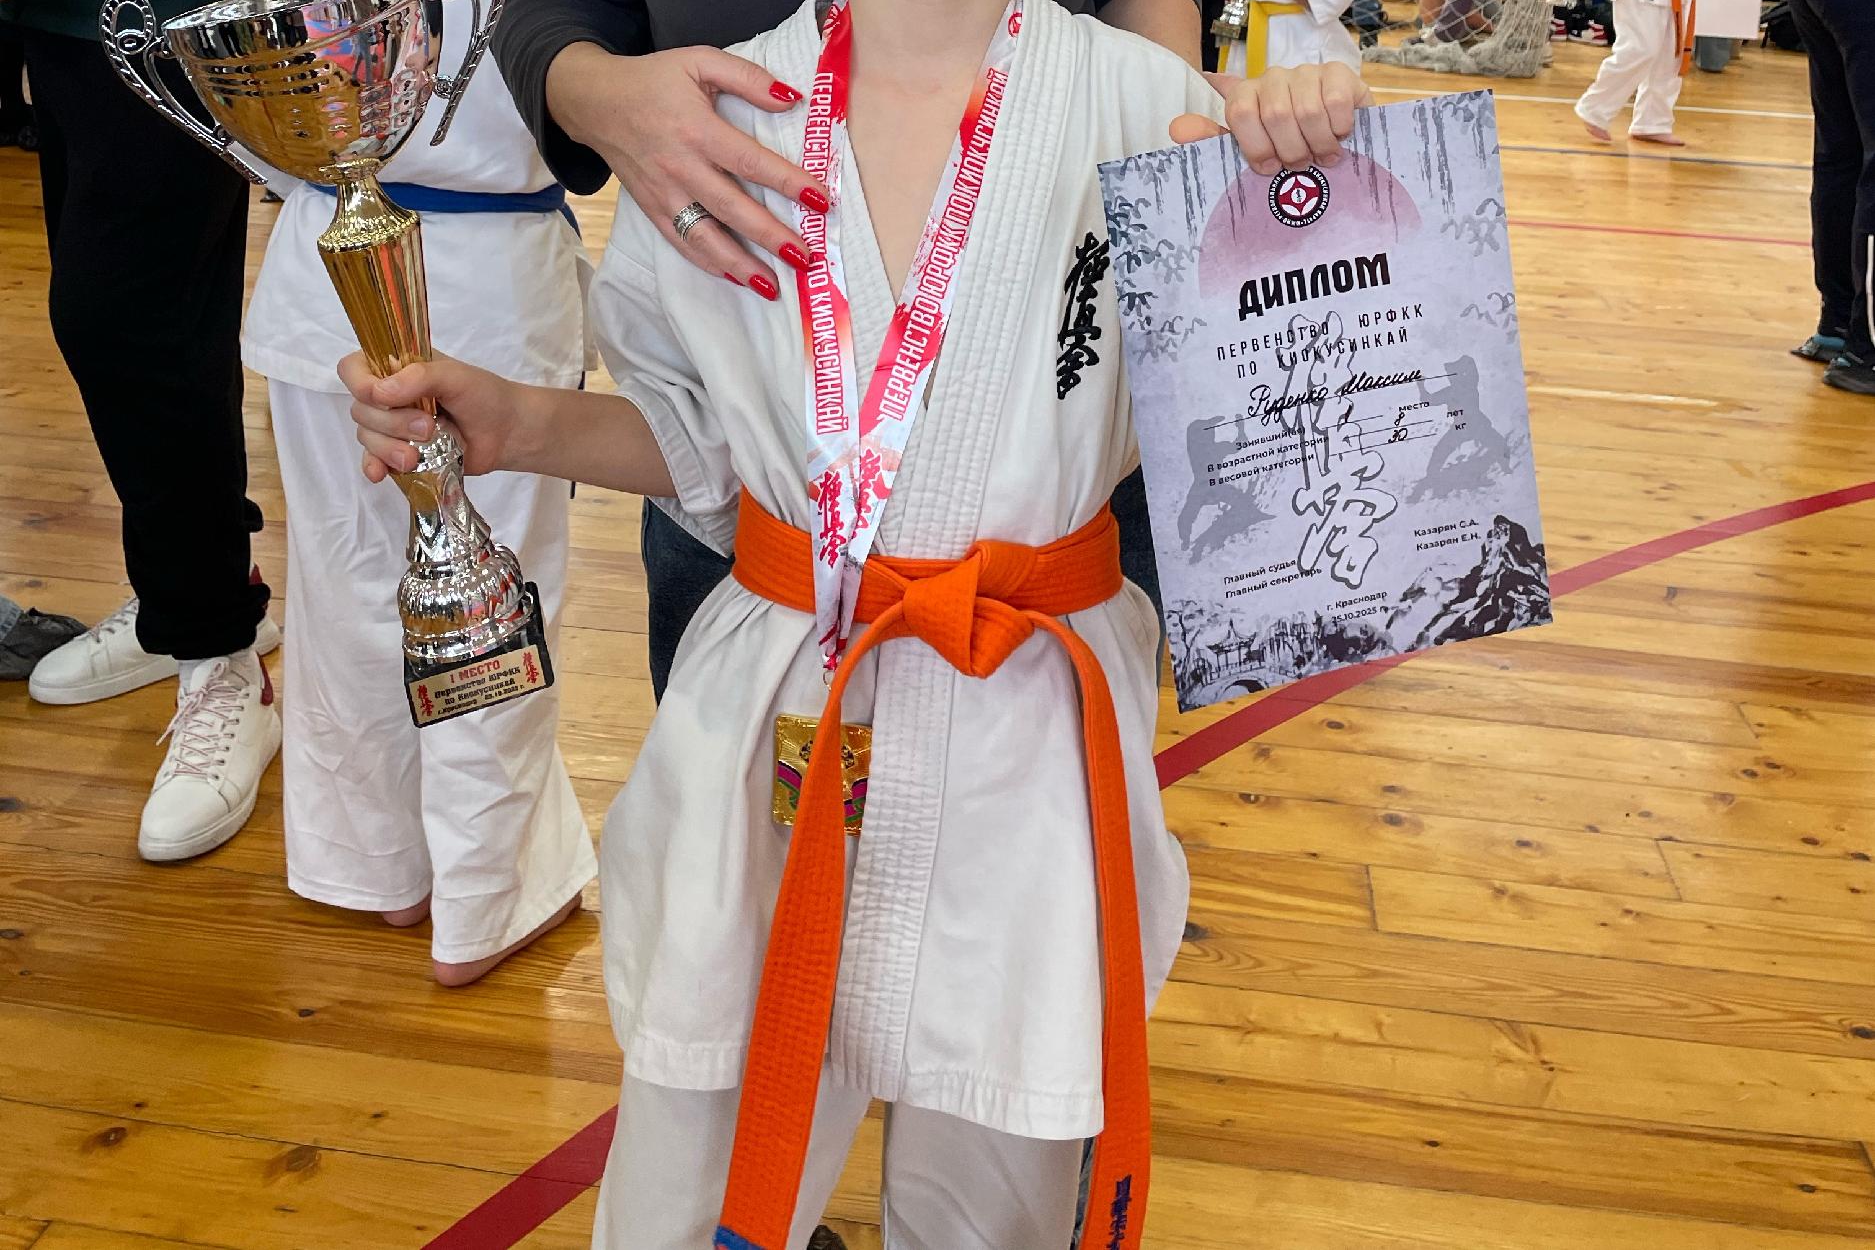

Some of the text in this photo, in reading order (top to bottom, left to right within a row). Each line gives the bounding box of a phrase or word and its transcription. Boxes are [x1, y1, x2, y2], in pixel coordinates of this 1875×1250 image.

[878, 67, 1009, 422] ПЕРВЕНСТВО ЮРФКК ПО КИОКУСИНКАЙ
[1238, 252, 1391, 321] ДИПЛОМ
[1217, 303, 1423, 361] ПЕРВЕНСТВО ЮРФКК
[1237, 325, 1408, 378] ПО КИОКУСИНКАЙ
[809, 291, 849, 434] КИОКУСИНКАЙ
[1339, 369, 1423, 397] Максим
[1207, 464, 1214, 472] В
[1217, 447, 1275, 470] возрастной
[1277, 435, 1329, 454] категории
[1209, 478, 1216, 487] В
[1218, 466, 1260, 485] весовой
[1262, 453, 1315, 473] категории
[1454, 422, 1467, 431] кг
[1223, 559, 1297, 586] Главный судья
[1225, 567, 1322, 599] Главный секретарь
[1335, 591, 1388, 609] Краснодар
[458, 659, 501, 681] МЕСТО
